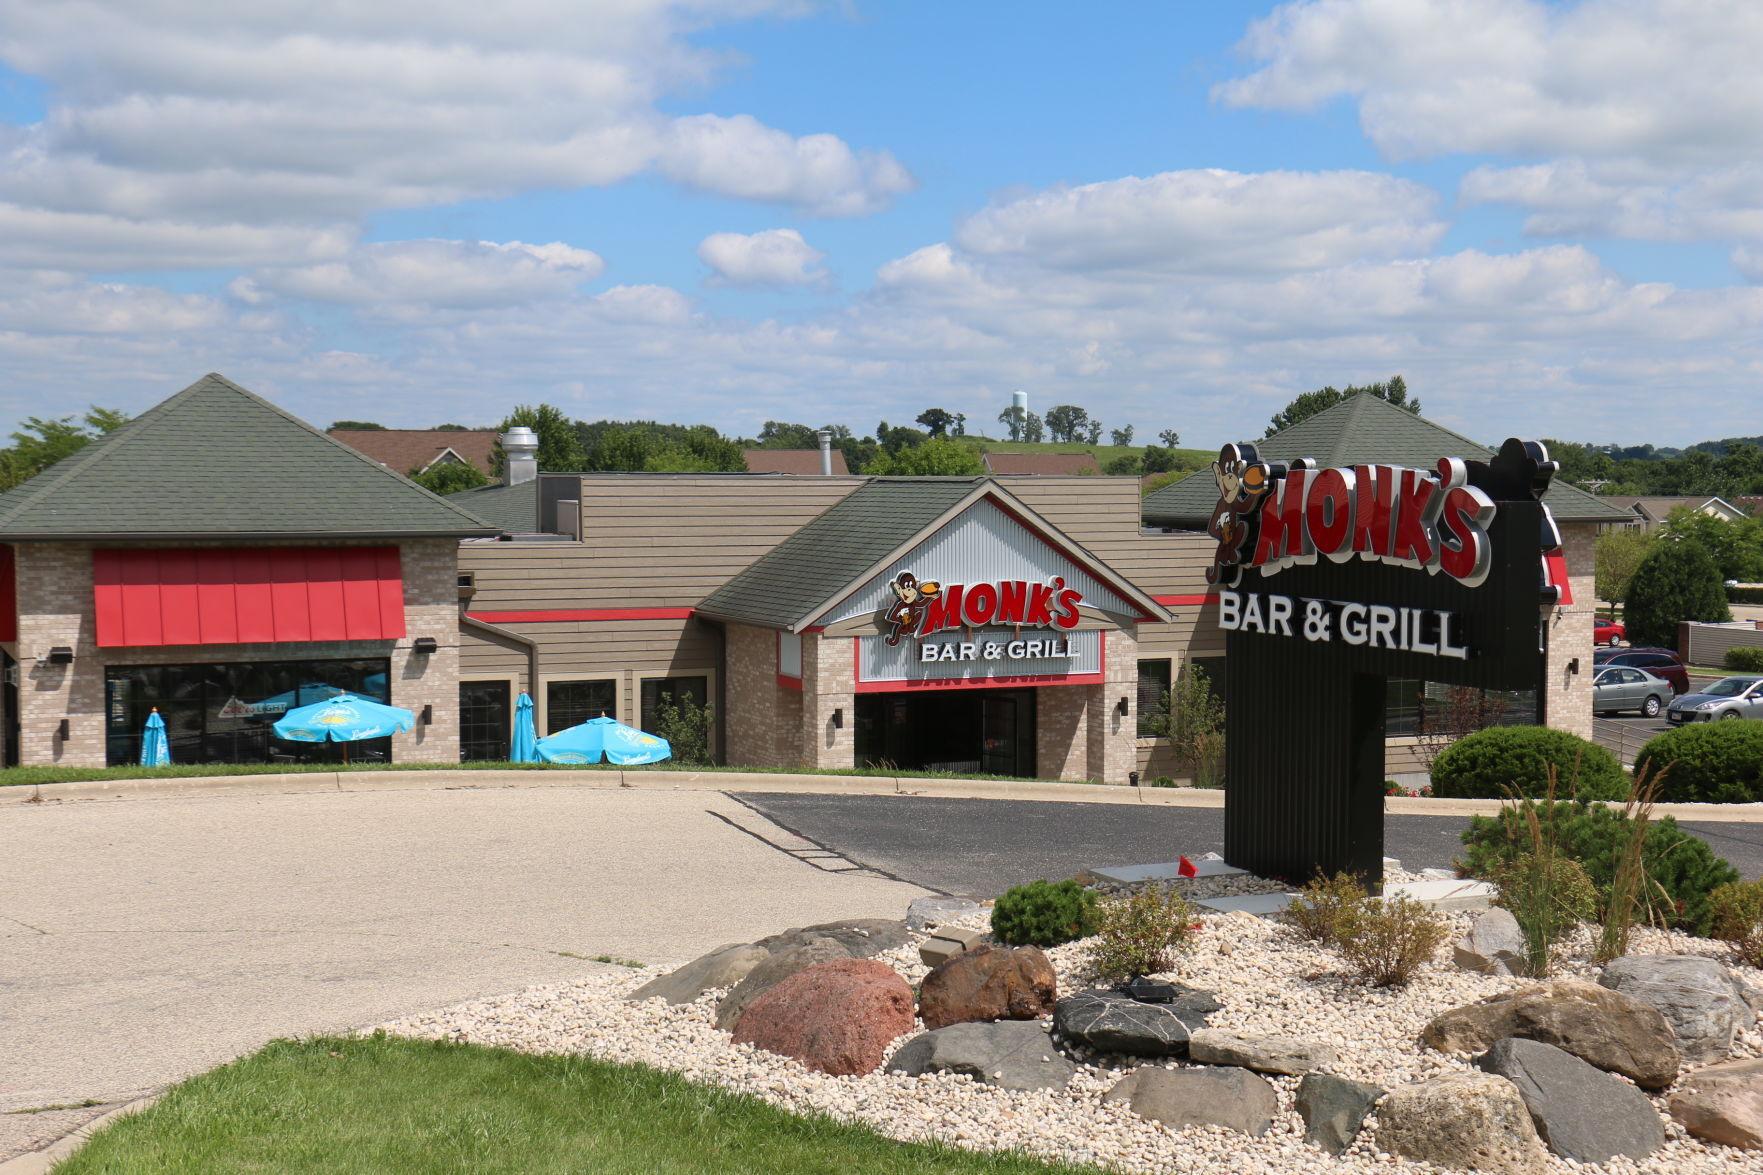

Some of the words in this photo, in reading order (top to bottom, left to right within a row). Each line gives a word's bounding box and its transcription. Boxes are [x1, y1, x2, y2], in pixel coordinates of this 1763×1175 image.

[1252, 457, 1496, 587] MONK'S
[917, 576, 1084, 637] MONK'S
[1218, 591, 1293, 637] BAR
[1303, 600, 1330, 642] &
[1340, 603, 1468, 661] GRILL
[921, 642, 977, 662] BAR
[983, 641, 1001, 660] &
[1007, 639, 1081, 659] GRILL
